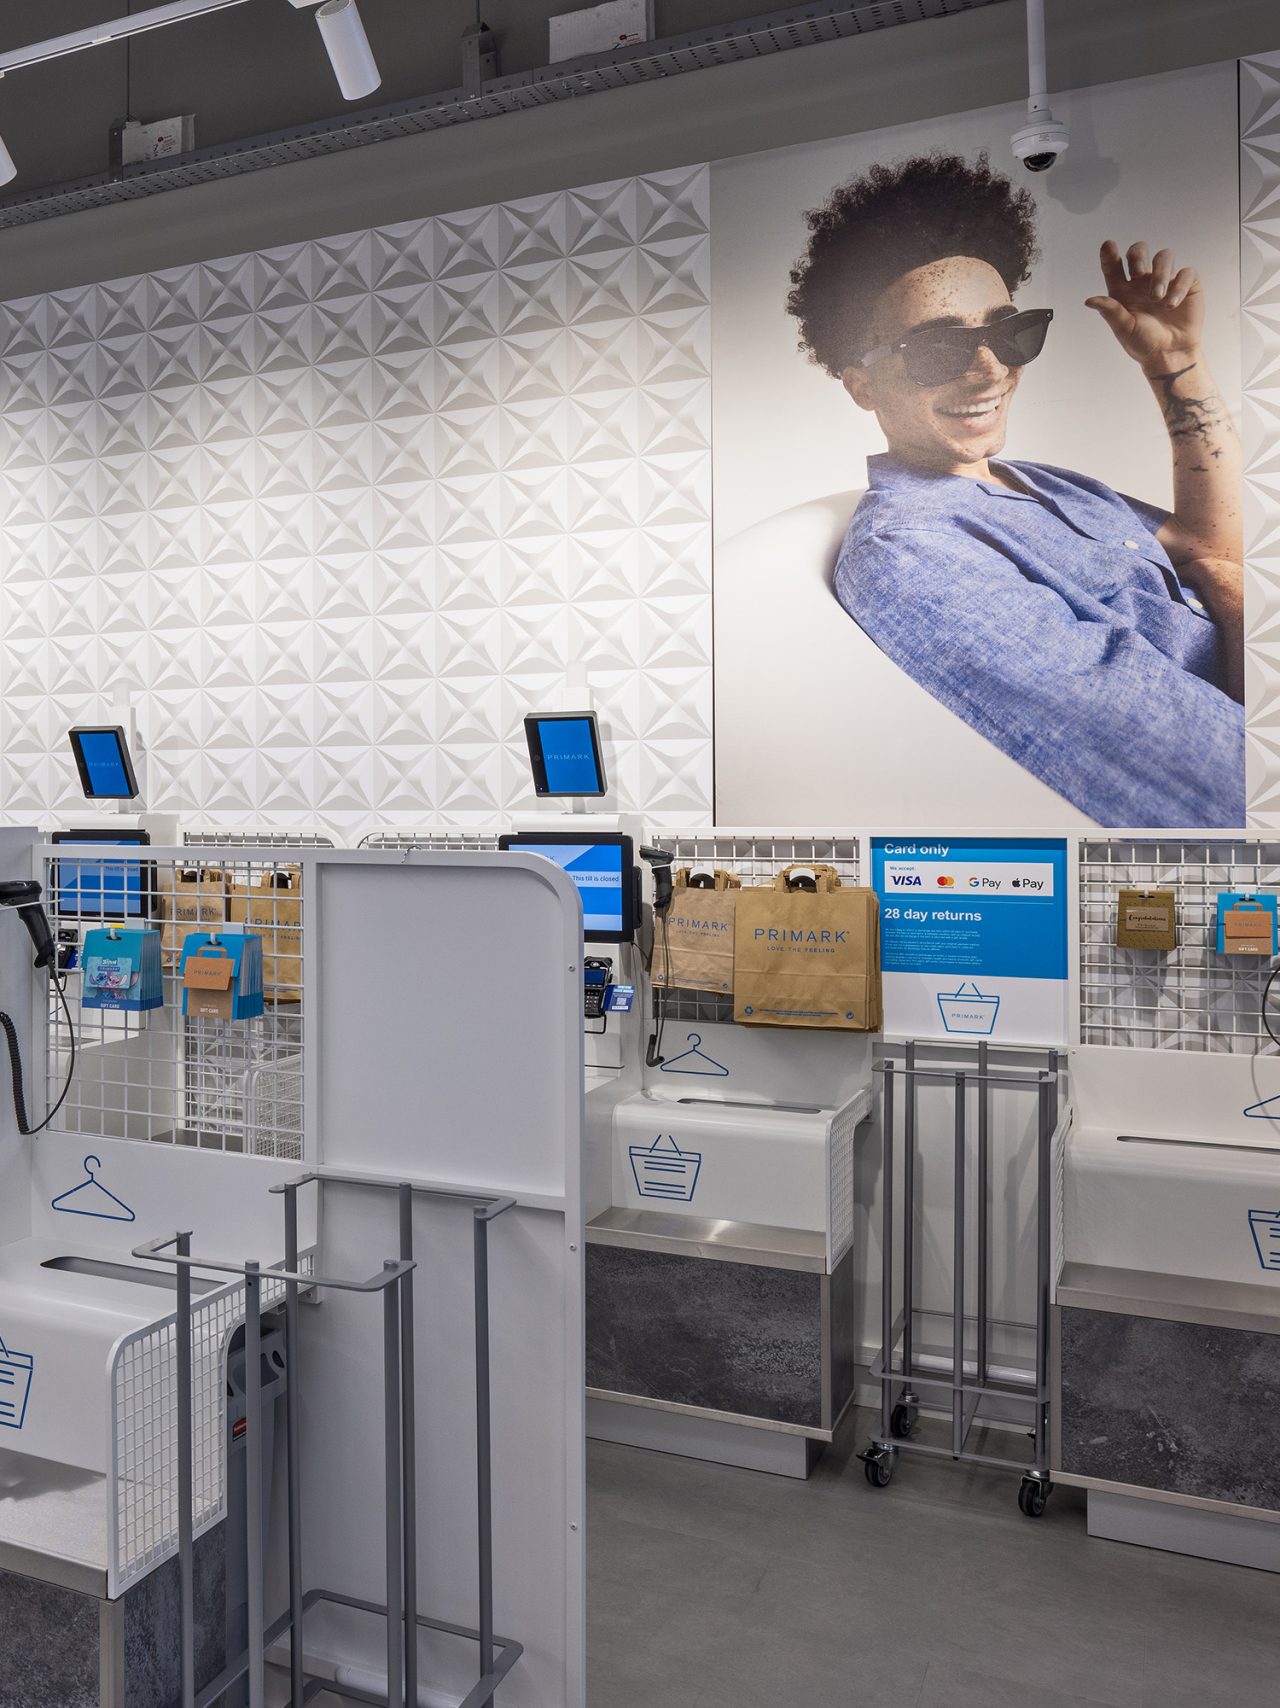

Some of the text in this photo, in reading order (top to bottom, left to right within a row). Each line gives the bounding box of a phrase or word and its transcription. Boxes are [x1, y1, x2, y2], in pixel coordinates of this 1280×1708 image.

[884, 843, 949, 857] Card only
[891, 875, 922, 886] VISA
[982, 877, 1001, 890] Pay
[1023, 878, 1044, 890] Pay
[884, 908, 982, 922] 28 day returns
[669, 917, 728, 931] PRIMARK
[754, 928, 846, 943] PRIMARK
